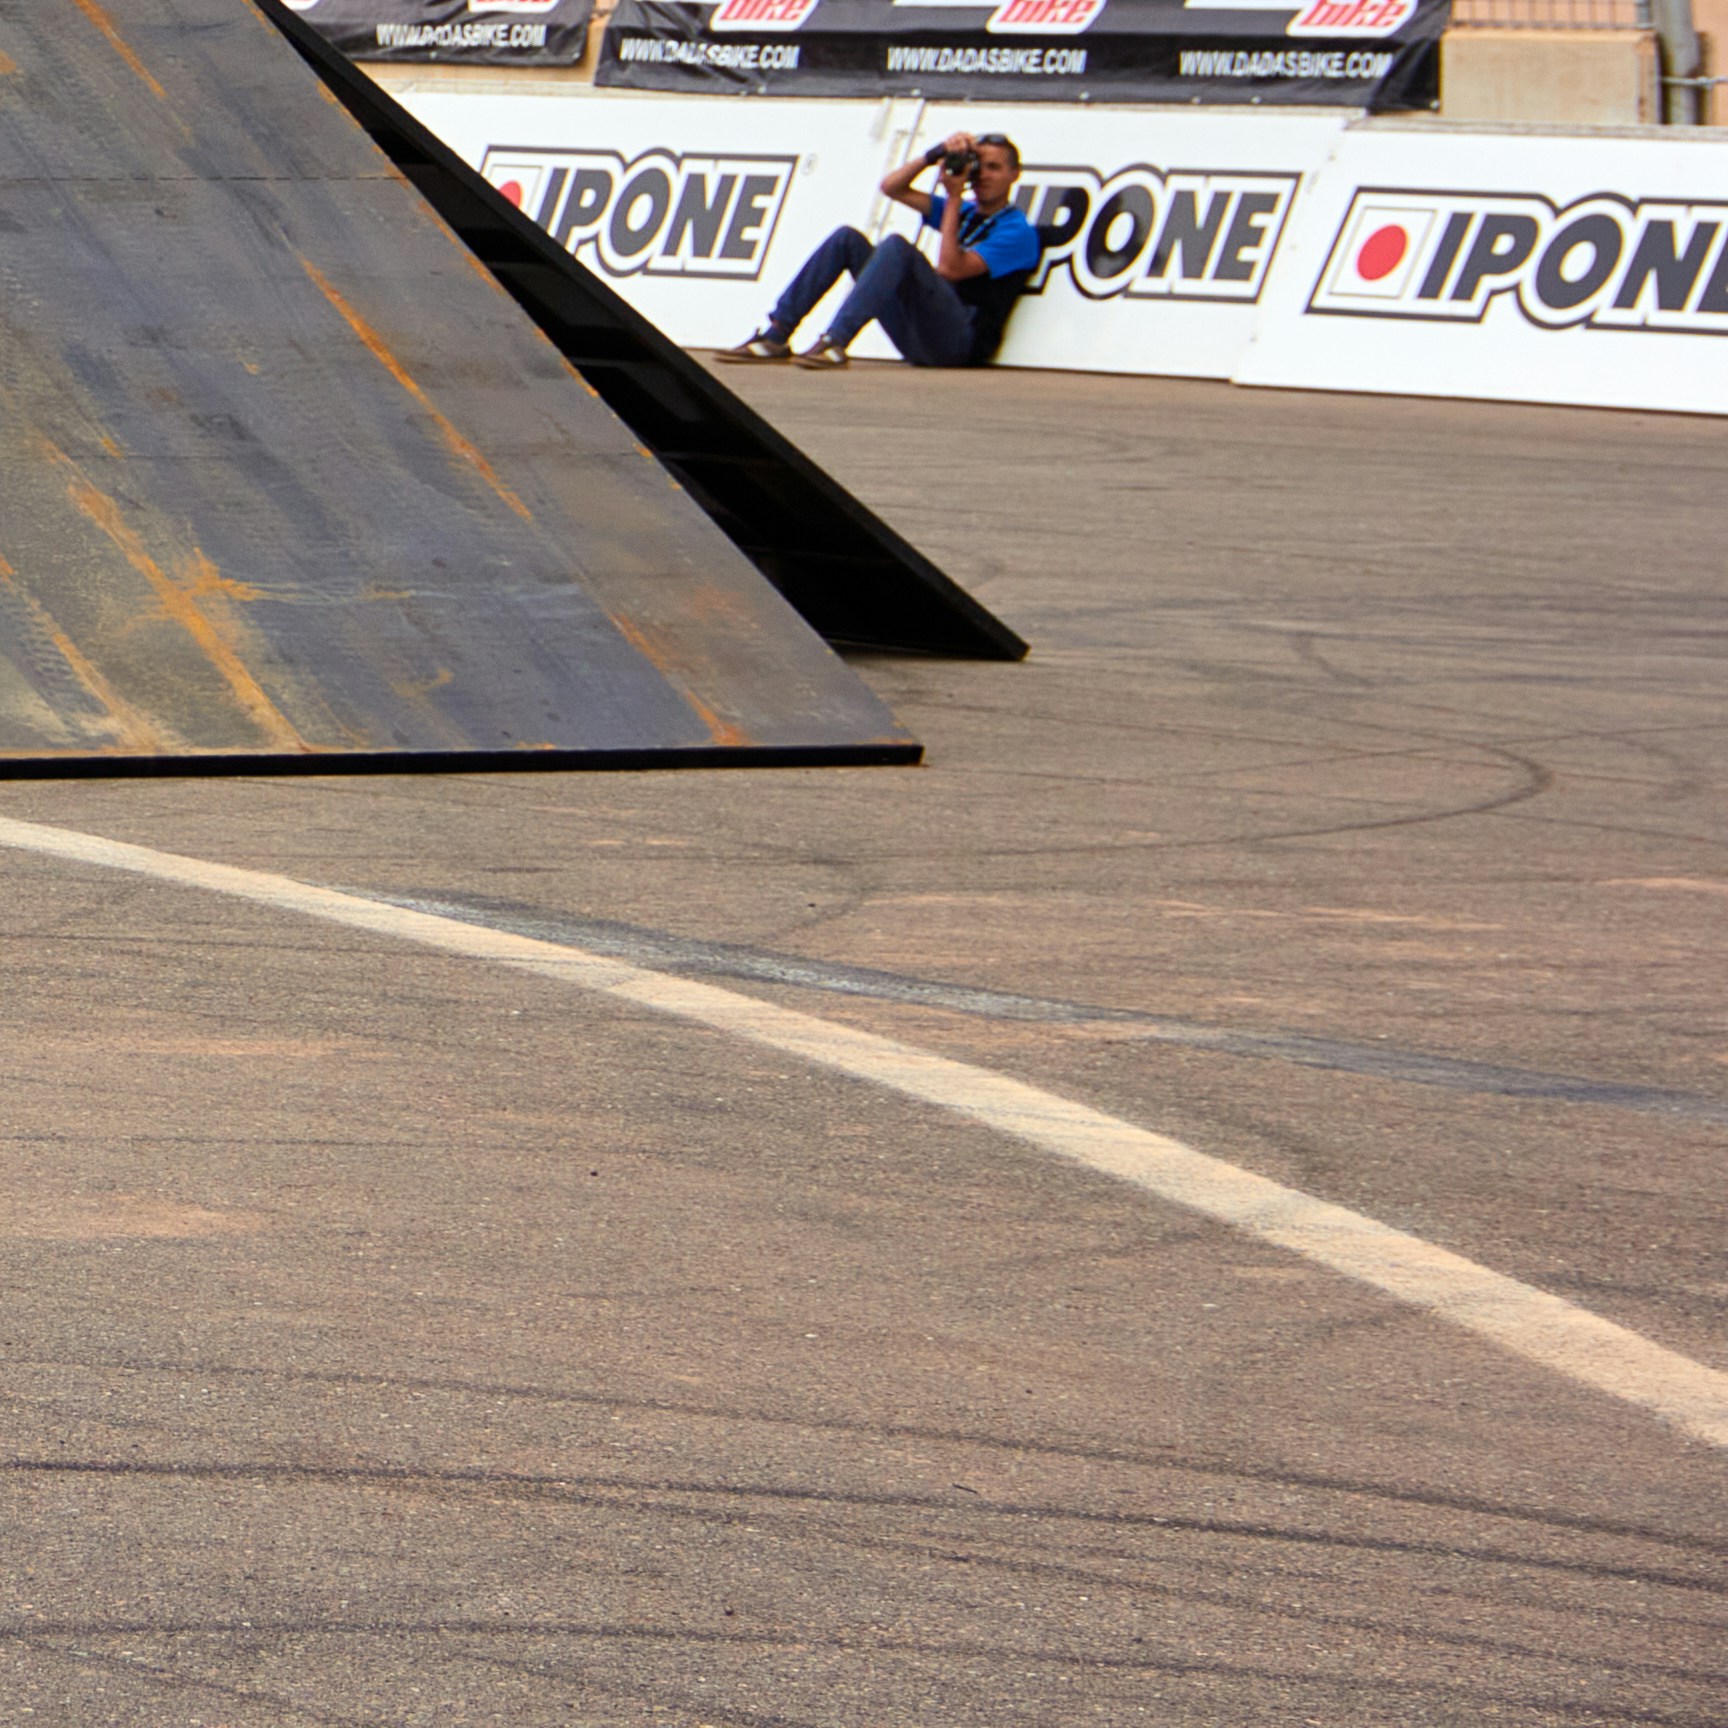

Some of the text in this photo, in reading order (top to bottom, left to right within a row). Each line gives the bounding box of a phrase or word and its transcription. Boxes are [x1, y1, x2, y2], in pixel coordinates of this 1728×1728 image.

[887, 46, 1088, 74] WWW.DADASBIKE.COM
[535, 166, 780, 261] IPONE
[1417, 211, 1728, 314] IPON
